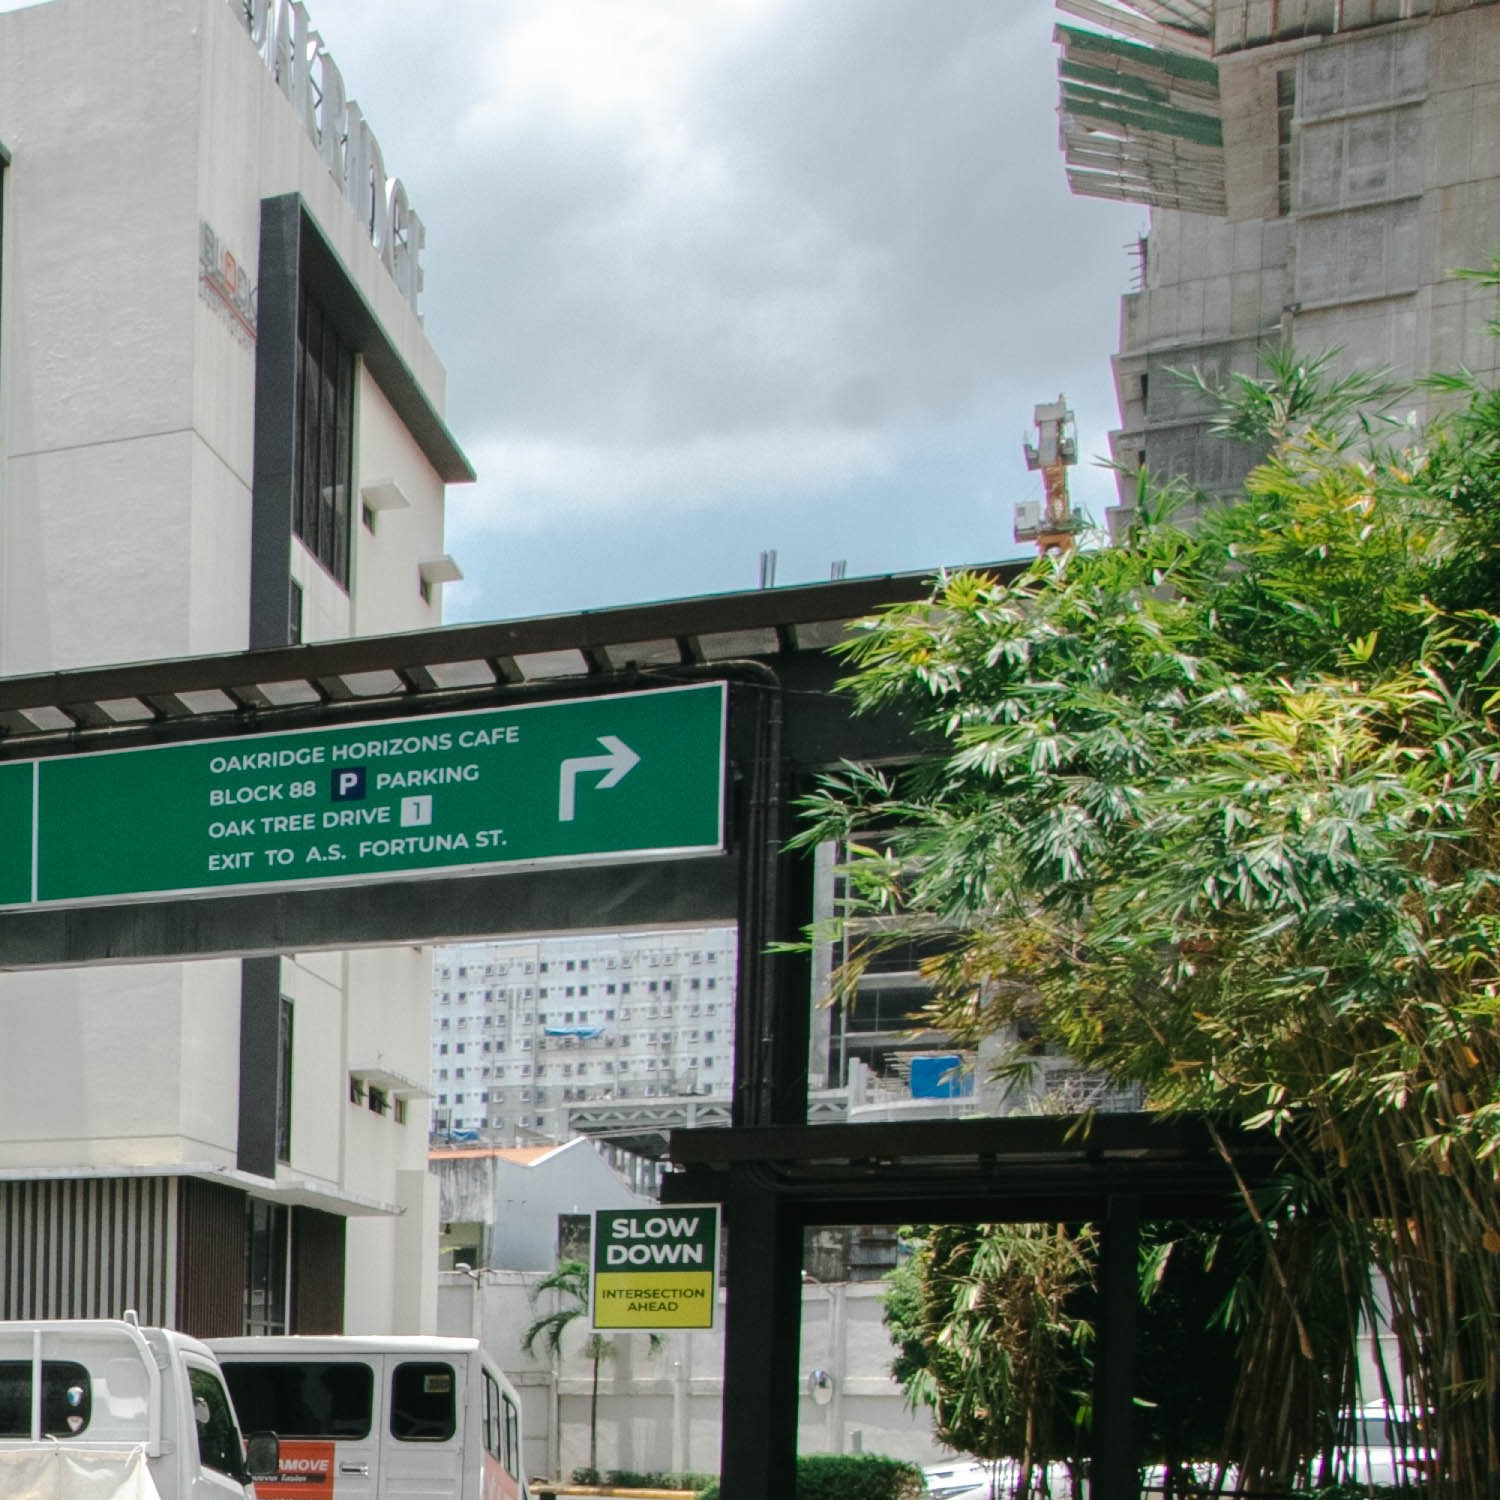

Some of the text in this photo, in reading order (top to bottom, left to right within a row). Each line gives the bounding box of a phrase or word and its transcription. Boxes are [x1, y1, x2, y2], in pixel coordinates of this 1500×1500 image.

[209, 726, 520, 774] OAKRIDGE HORIZONS CAFE
[209, 764, 480, 807] BLOCK 88 P PARKING
[208, 817, 255, 839] OAK
[261, 813, 316, 835] TREE
[322, 806, 391, 829] DRIVE
[208, 829, 508, 872] EXIT TO A.S. FORTUNA ST.
[612, 1217, 700, 1239] SLOW
[606, 1244, 704, 1265] DOWN
[602, 1288, 705, 1299] INTERSECTION
[627, 1301, 679, 1312] AHEAD
